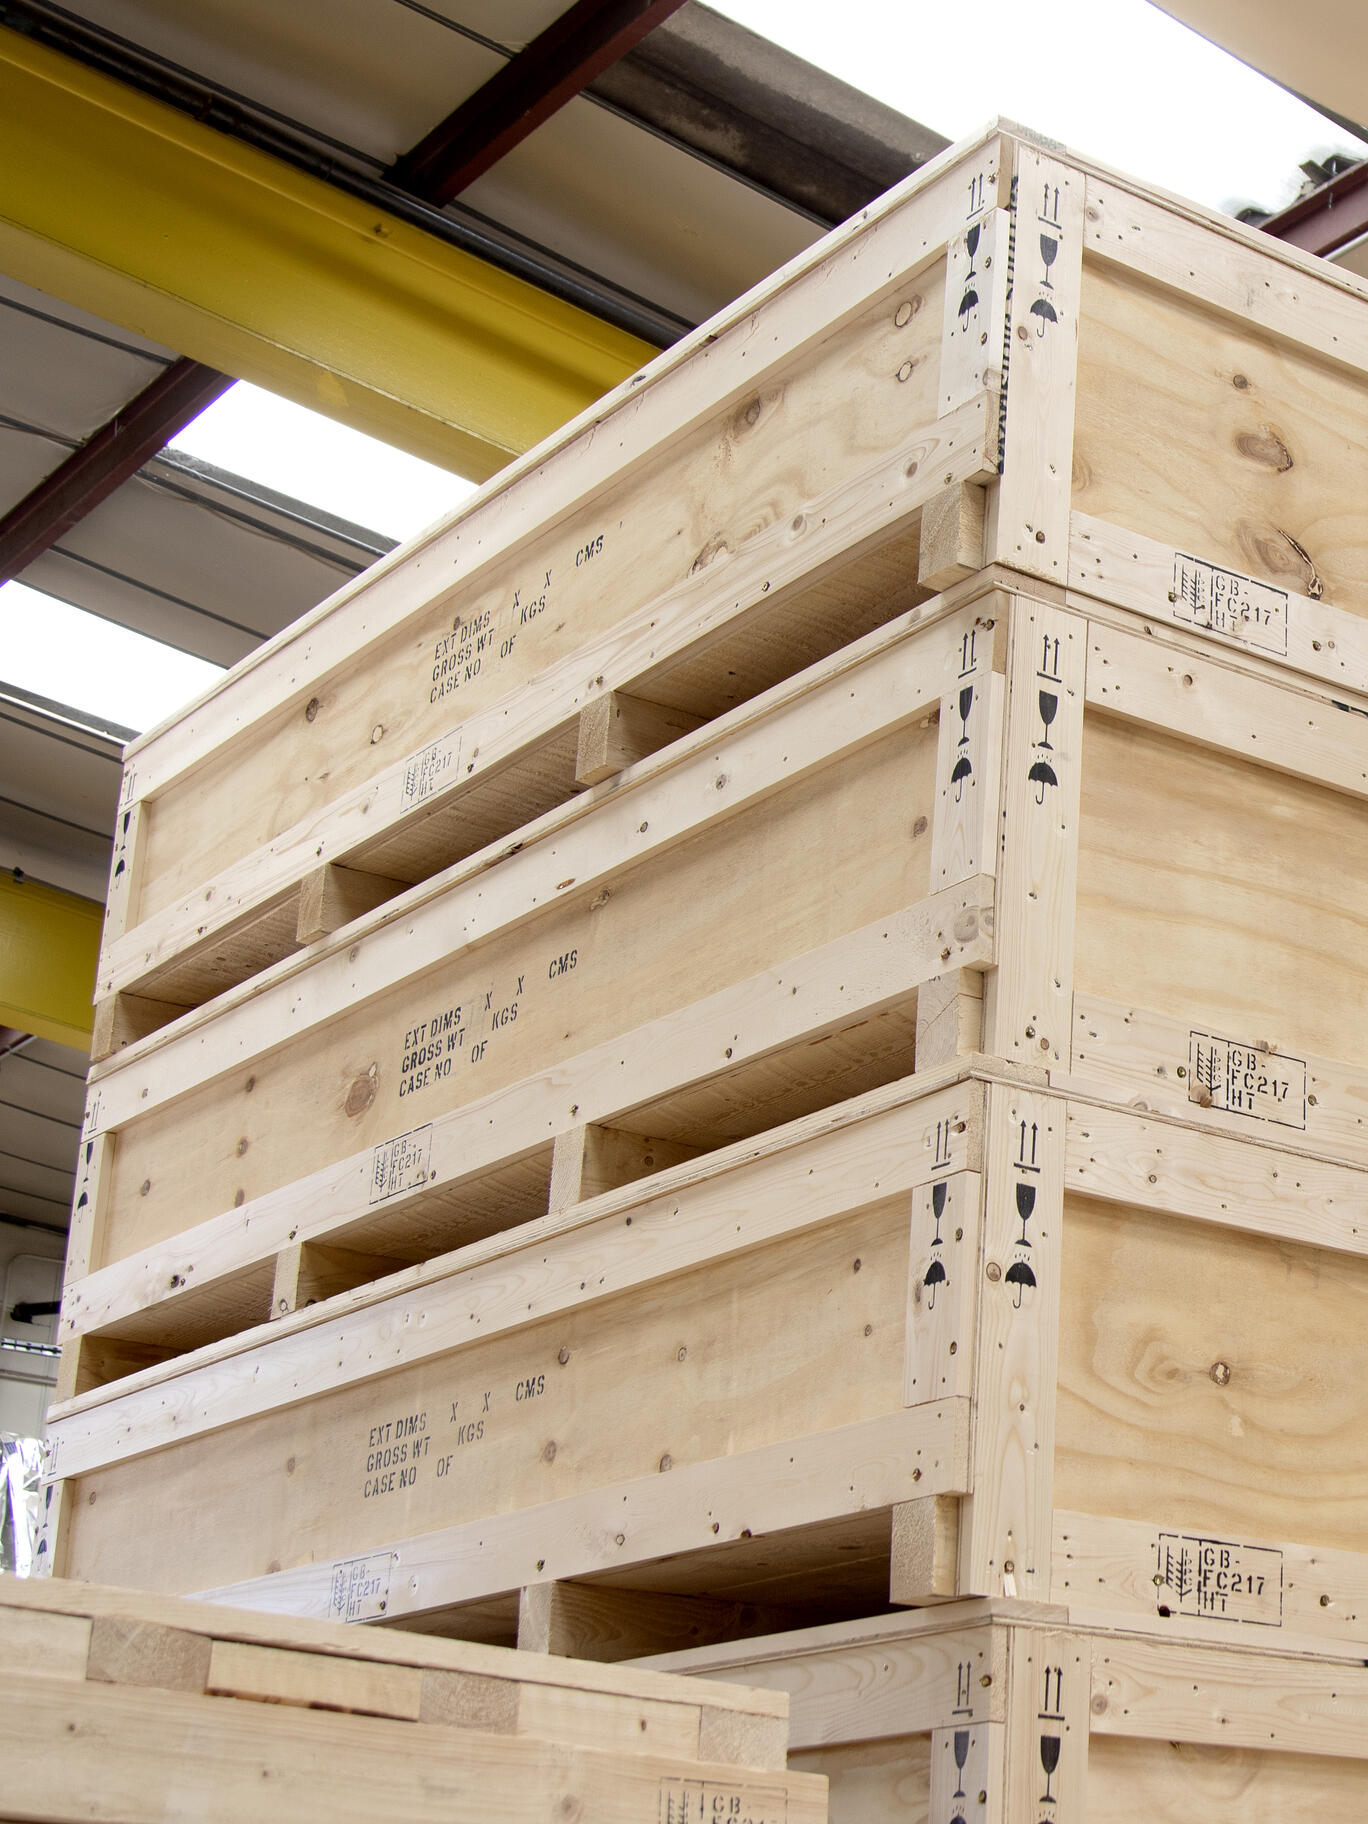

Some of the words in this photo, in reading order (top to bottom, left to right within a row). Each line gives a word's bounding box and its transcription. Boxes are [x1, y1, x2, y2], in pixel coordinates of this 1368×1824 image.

[435, 633, 456, 660] EXT
[461, 611, 490, 643] DIMS
[513, 590, 520, 609] X
[544, 570, 551, 589] X
[576, 535, 604, 567] CMS
[1216, 593, 1271, 625] FC217
[433, 644, 472, 682] GROSS
[477, 628, 494, 653] WT
[520, 595, 546, 625] KGS
[1216, 610, 1237, 631] HT
[430, 672, 460, 703] CASE
[464, 659, 481, 682] NO
[501, 635, 516, 658] OF
[405, 1024, 426, 1050] EXT
[431, 1007, 461, 1037] DIMS
[485, 992, 492, 1011] X
[517, 976, 524, 996] X
[549, 950, 577, 979] CMS
[402, 1040, 442, 1073] GROSS
[447, 1028, 465, 1052] WT
[492, 1003, 518, 1031] KGS
[400, 1068, 431, 1097] CASE
[435, 1059, 451, 1081] NO
[472, 1041, 488, 1063] OF
[1232, 1069, 1288, 1099] FC217
[1232, 1088, 1255, 1110] HT
[393, 1149, 422, 1174] FC217
[391, 1173, 403, 1190] HT
[369, 1424, 392, 1447] EXT
[396, 1413, 426, 1439] DIMS
[450, 1402, 458, 1422] X
[483, 1392, 490, 1412] X
[516, 1375, 544, 1401] CMS
[367, 1444, 407, 1472] GROSS
[413, 1437, 430, 1459] WT
[458, 1421, 484, 1445] KGS
[364, 1472, 396, 1498] CASE
[400, 1467, 416, 1488] NO
[437, 1455, 453, 1478] OF
[351, 1578, 381, 1599] FC217
[1203, 1569, 1264, 1595] FC217
[1204, 1591, 1228, 1612] HT
